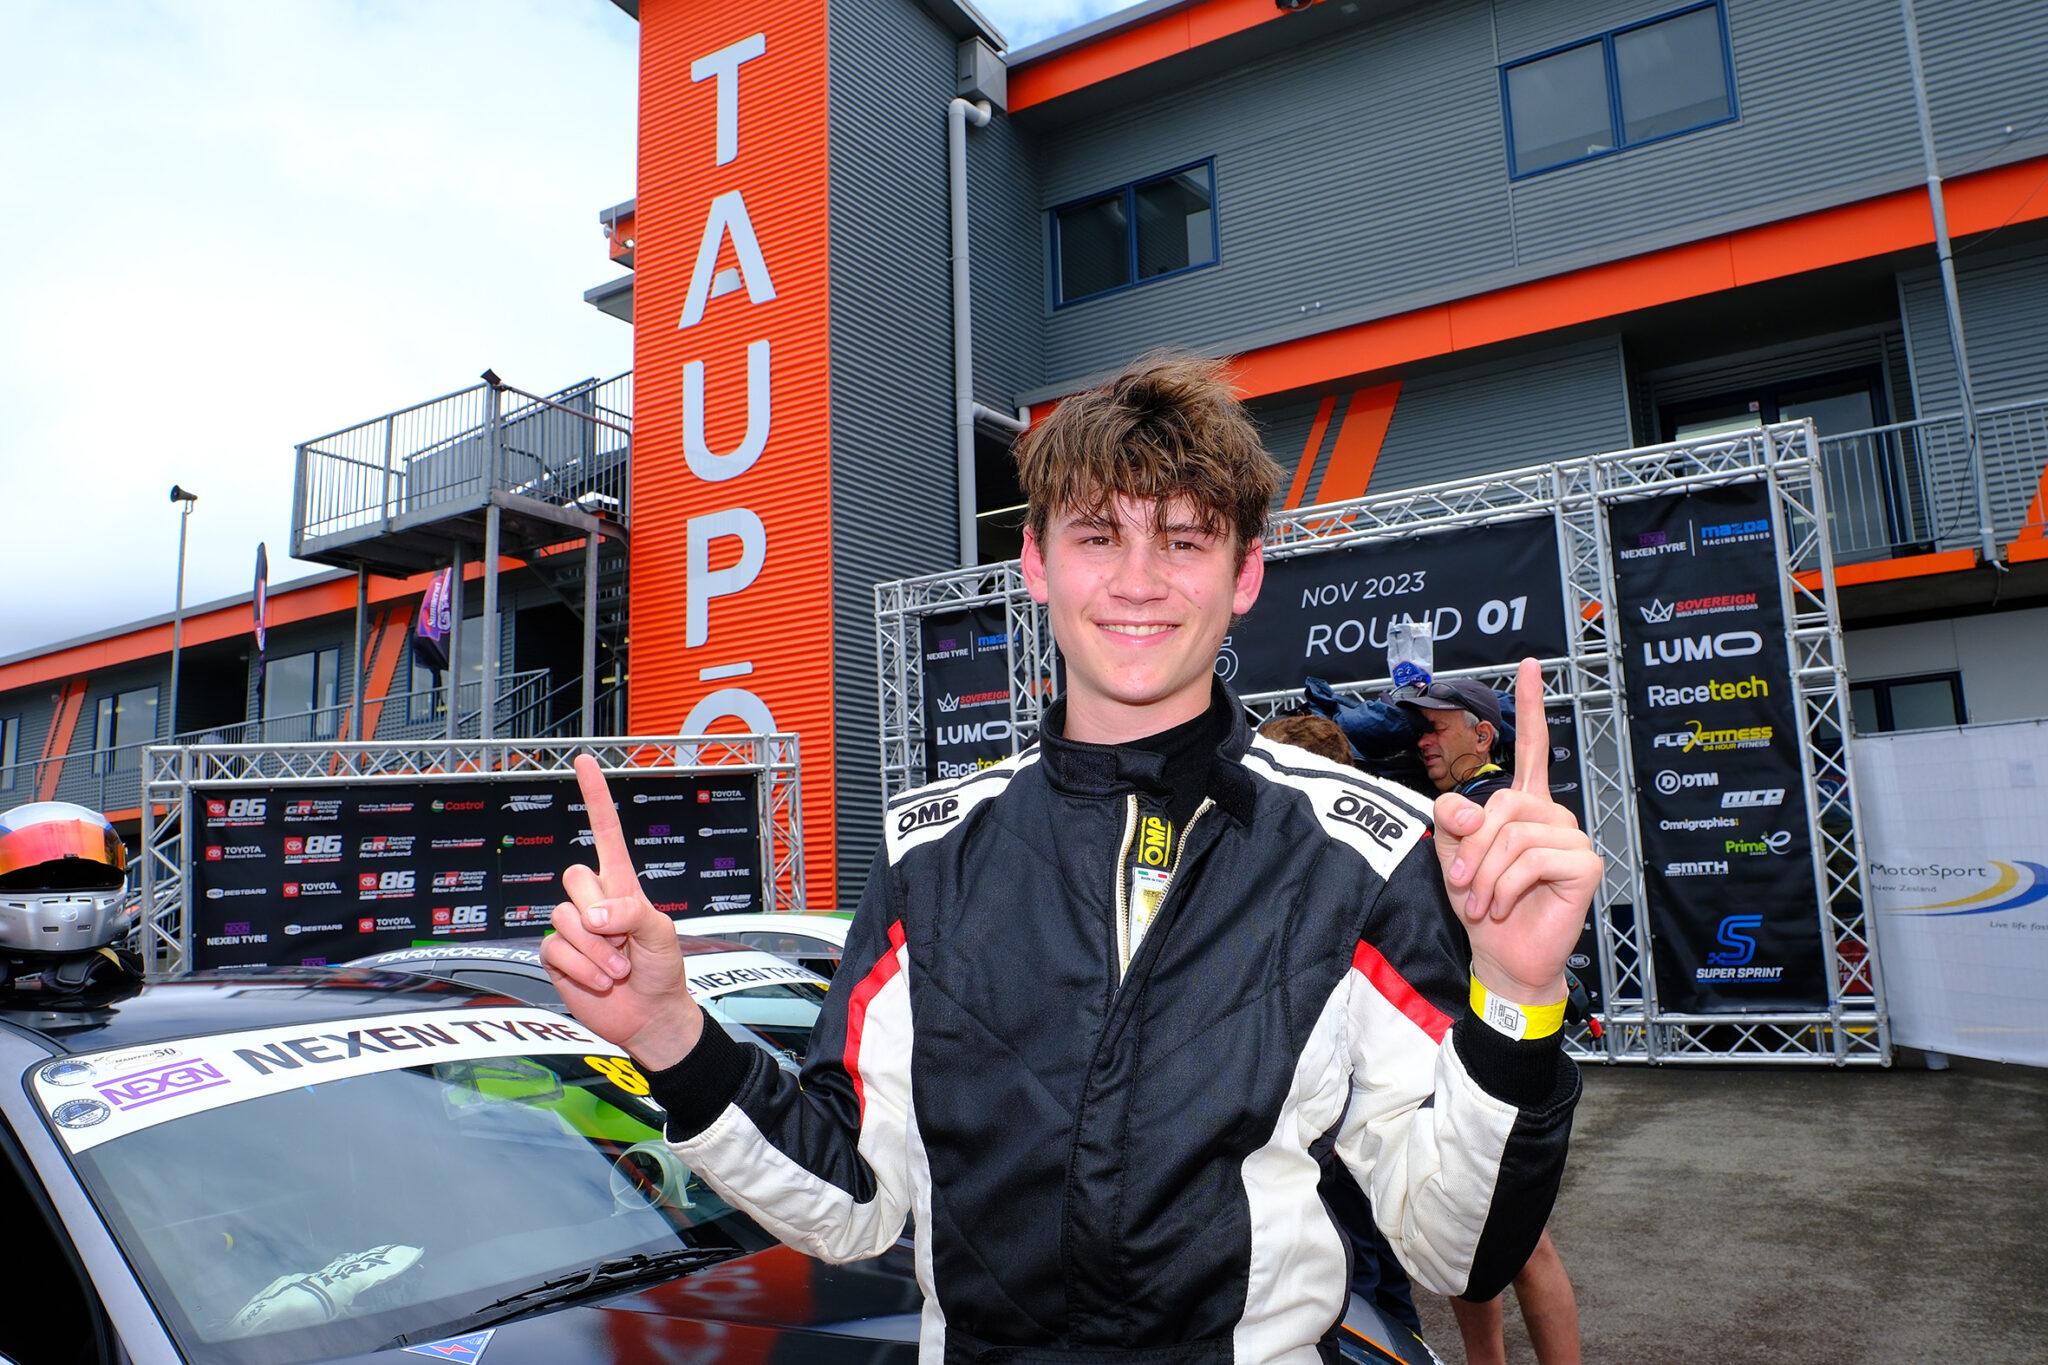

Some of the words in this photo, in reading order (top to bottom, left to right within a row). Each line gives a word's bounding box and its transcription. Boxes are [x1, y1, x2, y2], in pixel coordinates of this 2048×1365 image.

[1702, 536, 1737, 546] RACING
[1738, 532, 1770, 542] SERIES
[1620, 547, 1657, 560] NEXEN
[1657, 542, 1687, 554] TYRE
[1301, 582, 1358, 609] NOV
[1362, 571, 1426, 599] 2023
[1676, 593, 1757, 612] SOVEREIGN
[1477, 596, 1528, 635] 01
[927, 651, 949, 660] NEXEN
[950, 648, 969, 657] TYRE
[1643, 631, 1763, 666] LUMO
[960, 690, 1009, 704] SOVEREIGN
[1648, 675, 1769, 707] Racetech
[936, 720, 1011, 745] LUMO
[1715, 743, 1736, 751] HOUR
[1737, 740, 1771, 749] FITNESS
[937, 756, 1006, 778] Racete
[711, 790, 741, 798] TOYOTA
[228, 798, 267, 817] 86
[445, 801, 484, 811] Castrol
[568, 804, 588, 812] NEX
[897, 798, 959, 832] OMP
[1333, 796, 1403, 840] OMP
[1660, 817, 1736, 831] Omnigraphics
[305, 835, 342, 854] 86
[515, 836, 554, 845] Castrol
[634, 837, 661, 845] NEXEN
[663, 836, 685, 844] TYRE
[1144, 817, 1167, 865] OMP
[1725, 838, 1768, 854] Prime
[224, 846, 261, 854] TOYOTA
[700, 870, 727, 878] NEXEN
[728, 868, 750, 876] TYRE
[1870, 864, 1987, 879] MotorSport
[301, 882, 337, 891] TOYOTA
[379, 870, 416, 889] 86
[224, 888, 267, 896] BESTBARS
[1872, 884, 1896, 892] New
[1899, 884, 1937, 893] Zealand
[654, 901, 688, 912] Castrol
[376, 917, 411, 926] TOYOTA
[451, 905, 487, 924] 86
[302, 924, 342, 932] BESTBARS
[1989, 921, 2008, 929] Live
[207, 936, 239, 946] NEXEN
[241, 934, 267, 944] TYRE
[378, 947, 512, 963] DARKHORSE
[689, 967, 768, 991] NEXEN
[1696, 967, 1736, 979] SUPER
[1737, 966, 1784, 979] SPRINT
[154, 1047, 177, 1059] 50
[233, 1023, 460, 1075] NEXEN
[448, 1020, 595, 1044] TYRE
[98, 1063, 225, 1106] NEXEN
